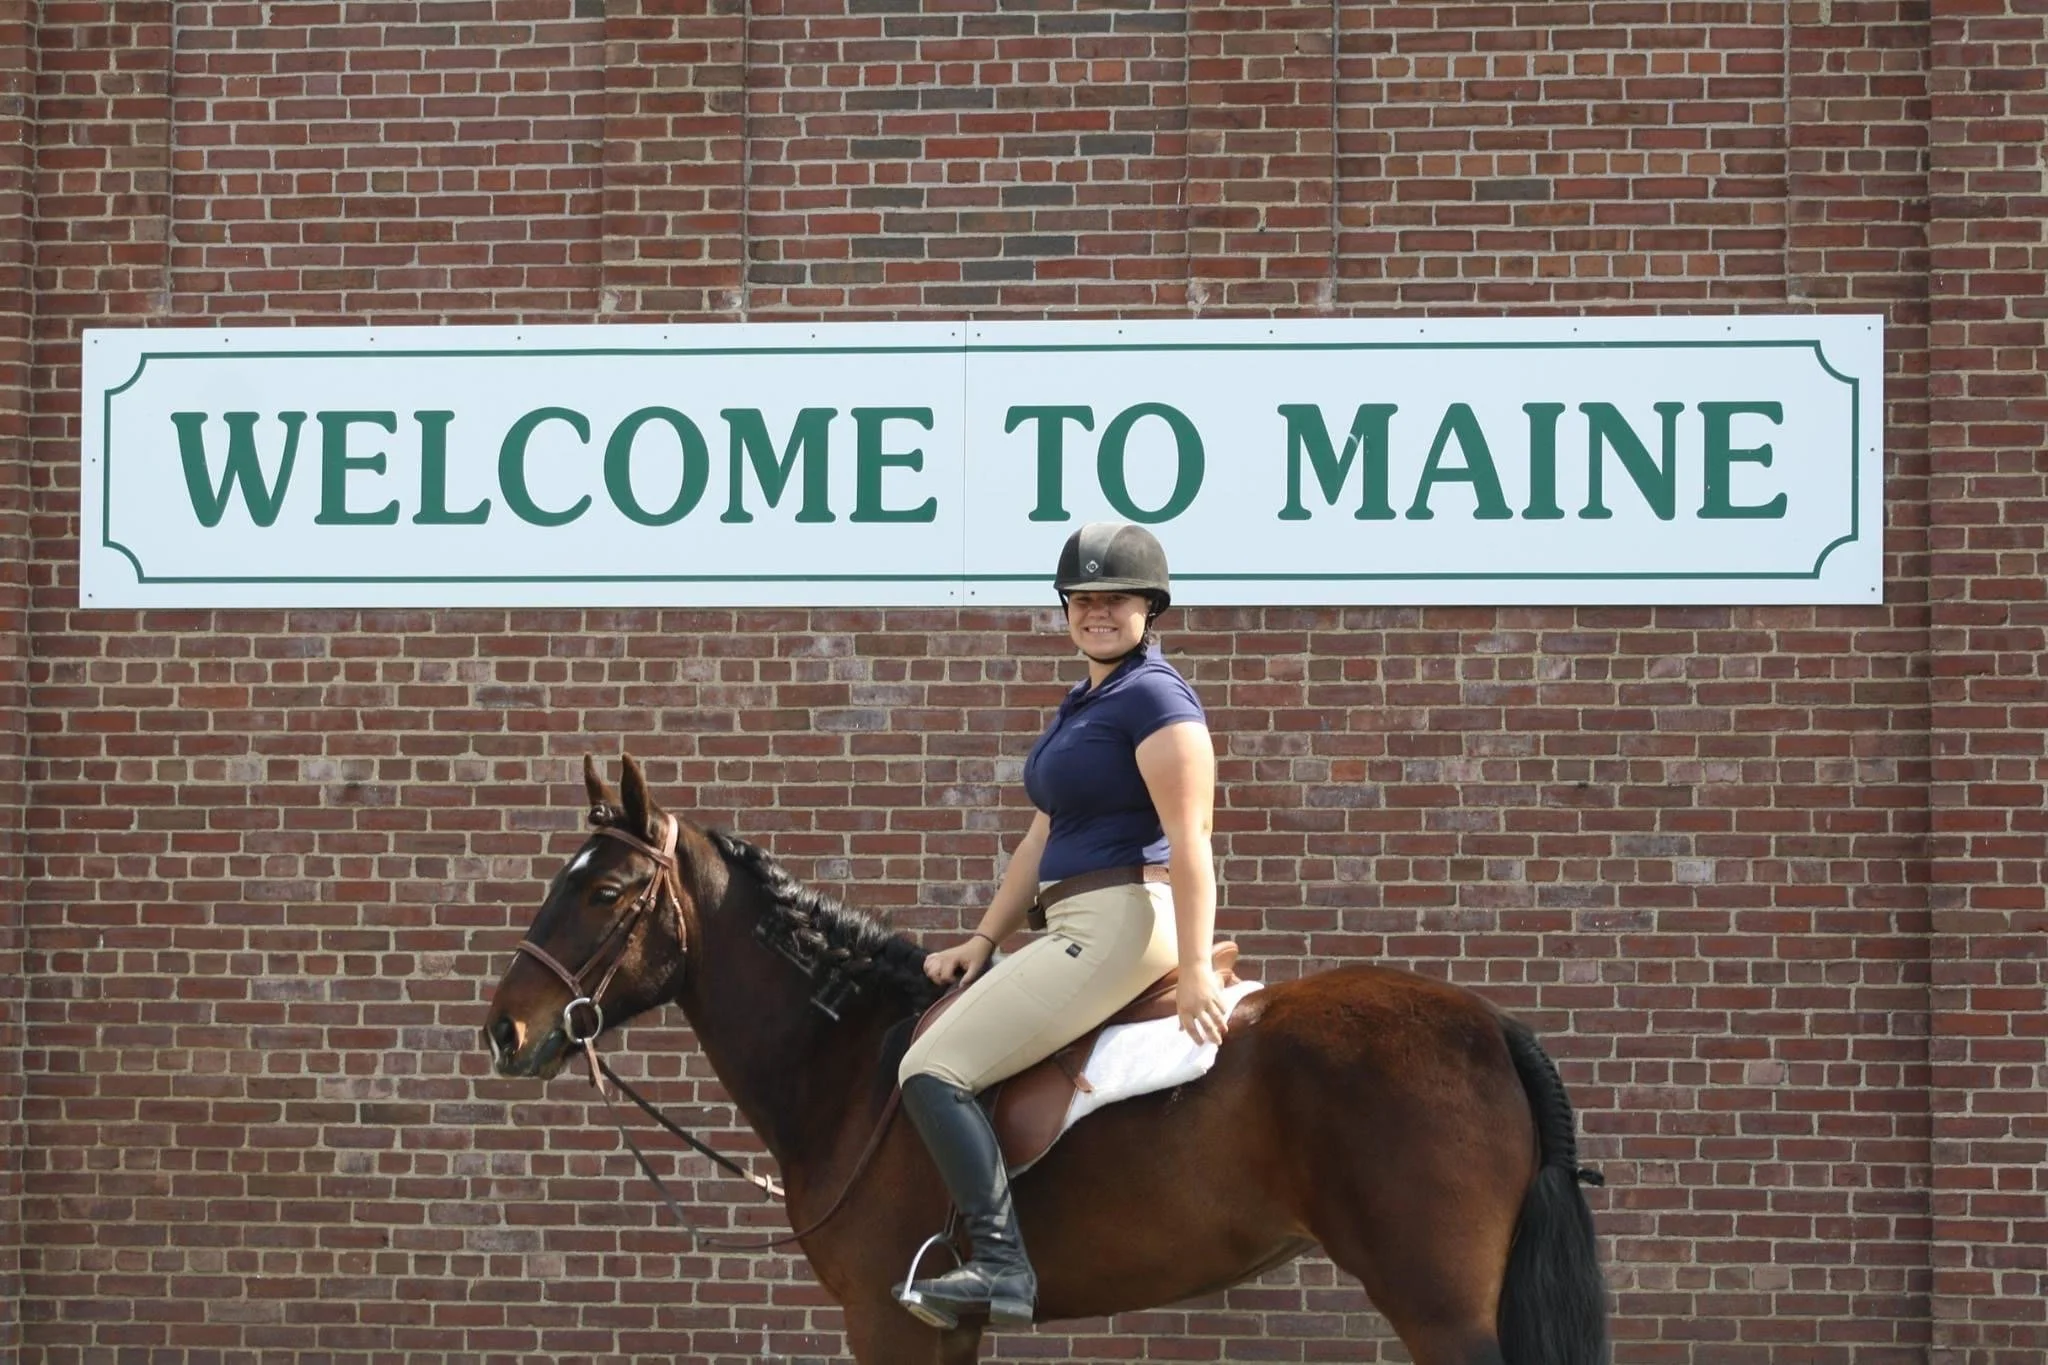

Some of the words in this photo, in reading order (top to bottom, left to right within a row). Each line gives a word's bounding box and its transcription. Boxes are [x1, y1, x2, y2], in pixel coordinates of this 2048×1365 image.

[171, 406, 937, 527] WELCOME
[1004, 402, 1205, 524] TO
[1277, 401, 1788, 521] MAINE
